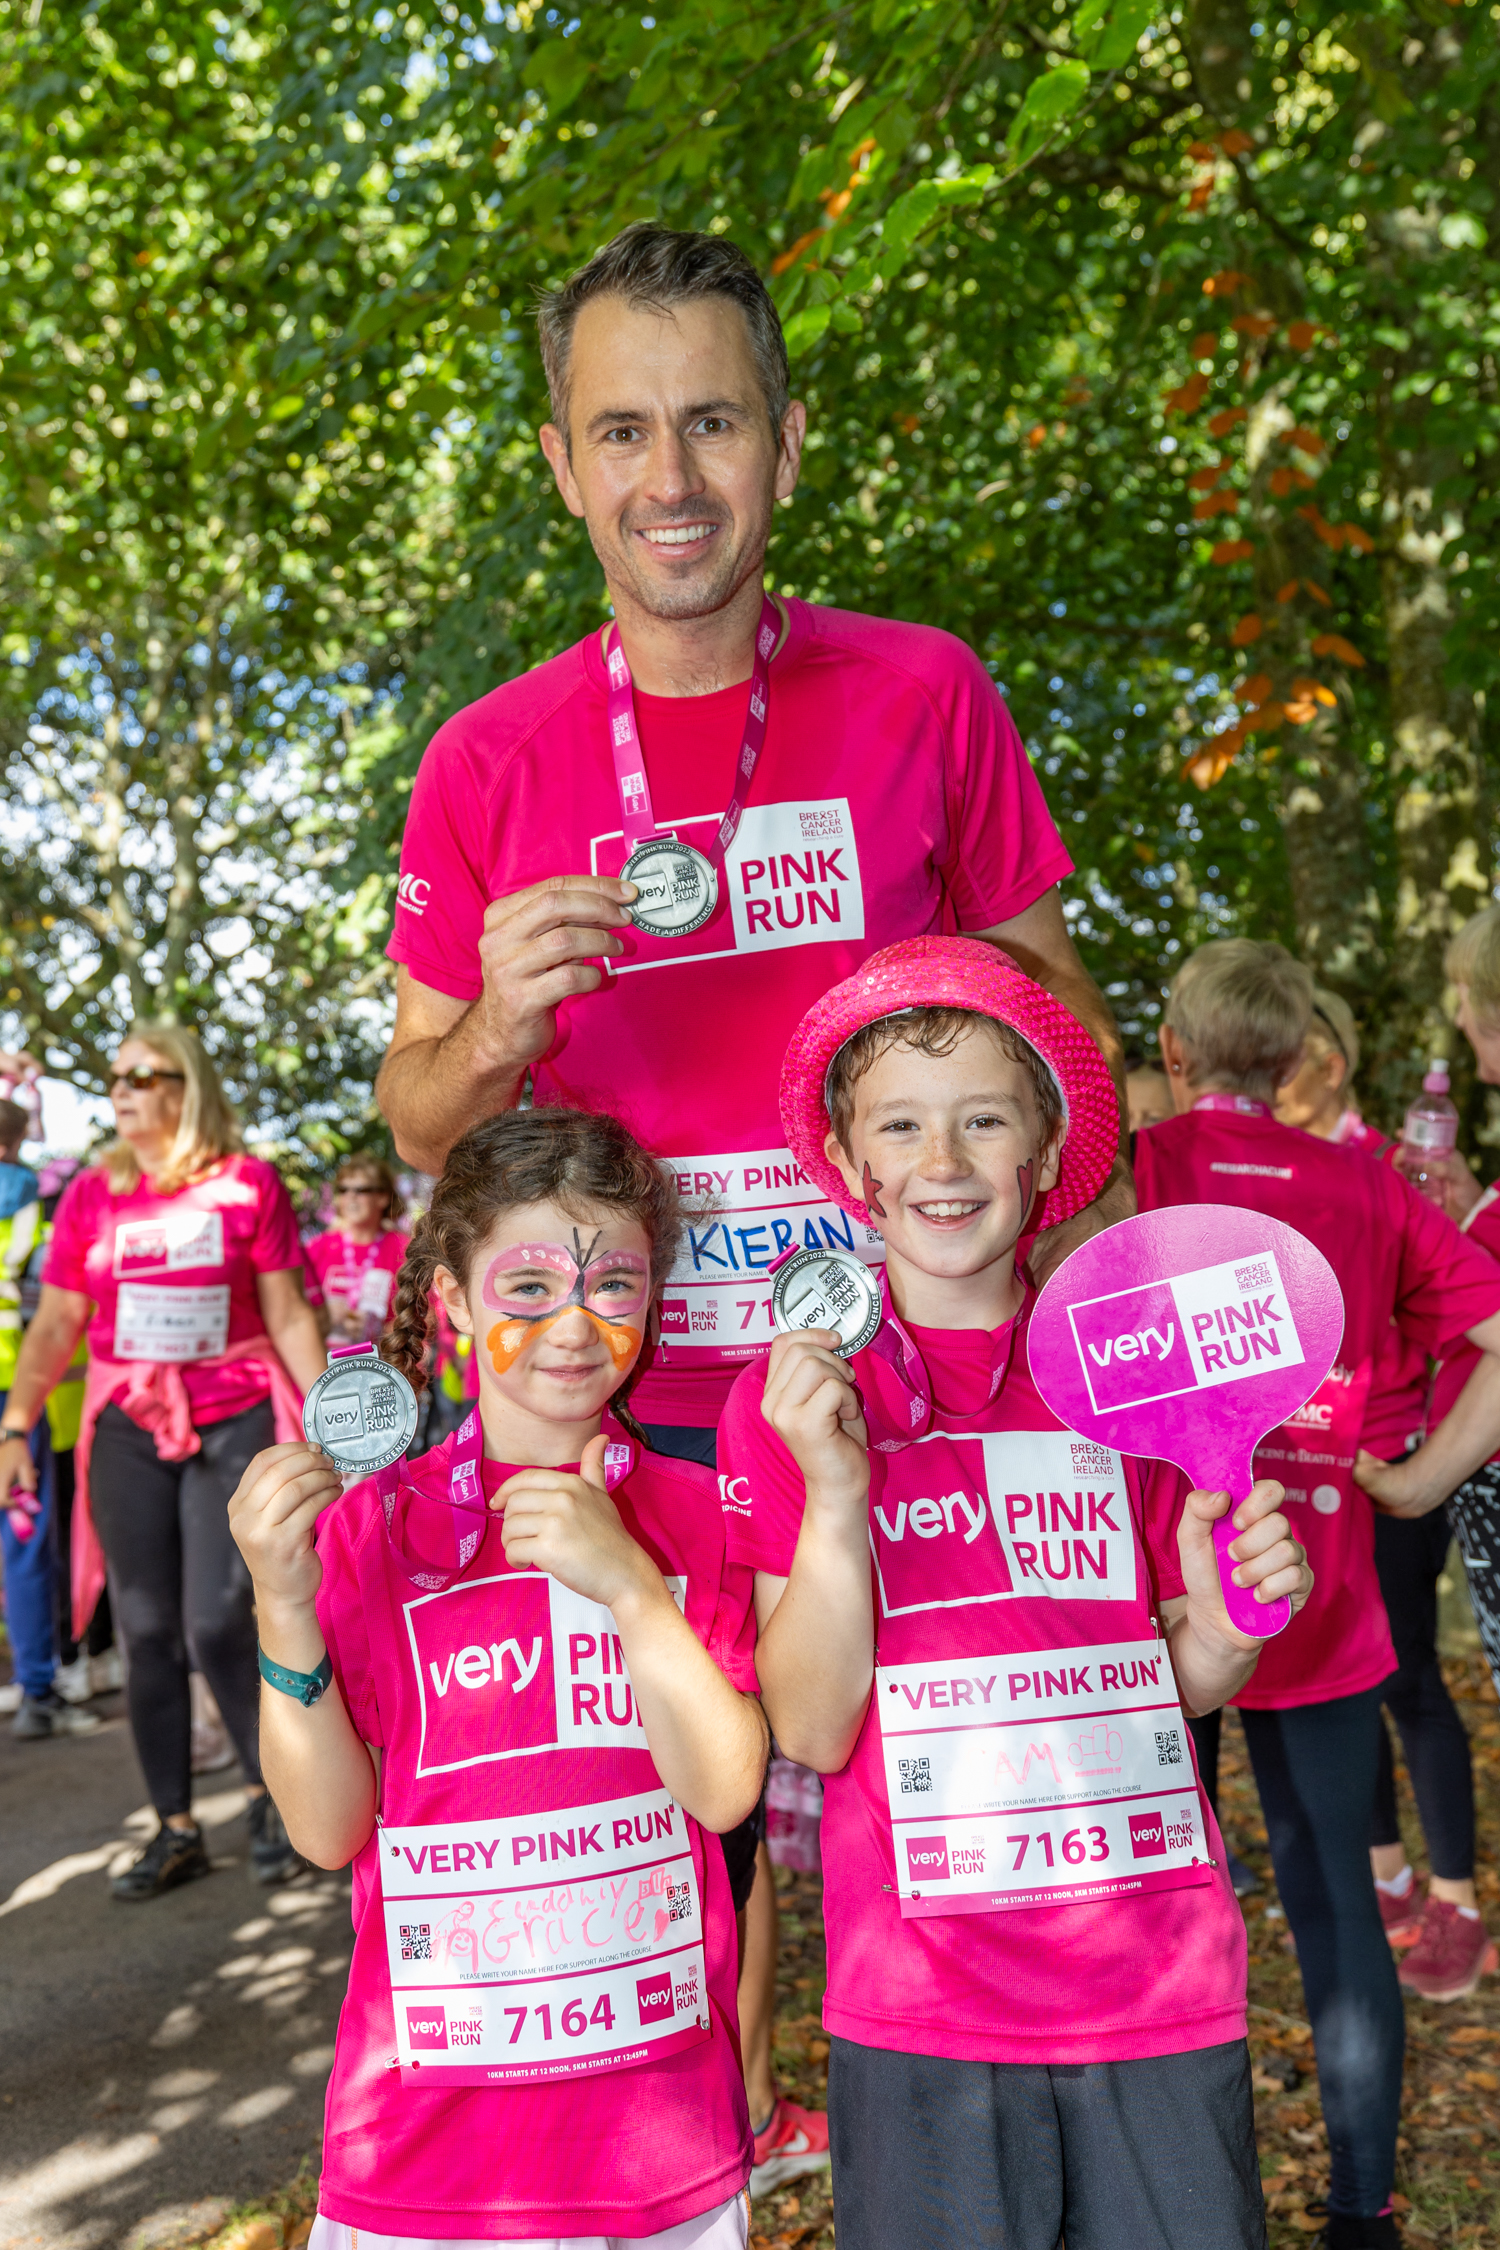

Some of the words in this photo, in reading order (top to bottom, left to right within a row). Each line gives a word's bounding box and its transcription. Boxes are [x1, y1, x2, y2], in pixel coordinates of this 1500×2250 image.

[801, 818, 841, 830] CANCER
[802, 826, 843, 837] IRELAND
[740, 848, 850, 895] PINK
[638, 885, 666, 899] very
[671, 878, 700, 894] PINK
[674, 888, 700, 902] RUN
[638, 920, 661, 934] MADE
[672, 902, 714, 935] DIFFERENCE
[745, 888, 841, 935] RUN
[744, 1163, 812, 1191] PINK
[688, 1207, 855, 1271] KIERAN
[774, 1282, 786, 1302] VERY
[781, 1267, 794, 1283] PINK
[792, 1256, 808, 1268] RUN
[808, 1252, 826, 1260] 2023
[1236, 1270, 1270, 1284] CANCER
[1238, 1276, 1272, 1290] IRELAND
[826, 1277, 854, 1306] PINK
[834, 1288, 860, 1314] RUN
[661, 1311, 686, 1324] very
[691, 1311, 719, 1321] PINK
[736, 1298, 776, 1330] 71
[799, 1302, 826, 1329] very
[848, 1346, 854, 1354] A
[854, 1294, 879, 1348] DIFFERENCE
[1191, 1294, 1284, 1342] PINK
[692, 1322, 716, 1331] RUN
[737, 1348, 756, 1356] STARTS
[1087, 1322, 1175, 1367] very
[1200, 1328, 1282, 1373] RUN
[319, 1369, 335, 1386] VERY
[336, 1362, 354, 1373] PINK
[356, 1360, 373, 1368] RUN
[374, 1362, 392, 1375] 2023
[325, 1410, 358, 1425] very
[365, 1404, 397, 1420] PINK
[366, 1416, 395, 1432] RUN
[360, 1434, 411, 1471] DIFFERENCE
[1072, 1455, 1112, 1465] CANCER
[1073, 1465, 1114, 1475] IRELAND
[459, 1478, 469, 1499] very
[873, 1490, 987, 1545] very
[1004, 1491, 1122, 1534] PINK
[1011, 1539, 1108, 1581] RUN
[429, 1636, 543, 1698] very
[900, 1675, 998, 1710] VERY
[1008, 1666, 1094, 1701] PINK
[1099, 1658, 1160, 1691] RUN
[571, 1682, 643, 1727] RU
[1020, 1797, 1038, 1805] NAME
[1038, 1795, 1053, 1803] HERE
[1054, 1794, 1066, 1802] FOR
[1067, 1790, 1092, 1800] SUPPORT
[1093, 1788, 1112, 1797] ALONG
[1122, 1784, 1142, 1793] COURSE
[1132, 1826, 1162, 1842] very
[1166, 1822, 1194, 1836] PINK
[402, 1839, 500, 1875] VERY
[511, 1824, 605, 1866] PINK
[612, 1808, 674, 1849] RUN
[1006, 1825, 1110, 1872] 7163
[1168, 1834, 1192, 1849] RUN
[910, 1851, 946, 1867] very
[952, 1848, 986, 1862] PINK
[953, 1862, 984, 1874] RUN
[991, 1898, 1009, 1906] 10KM
[1010, 1896, 1033, 1904] STARTS
[1052, 1891, 1074, 1900] NOON,
[1074, 1889, 1088, 1897] 5KM
[1088, 1886, 1110, 1896] STARTS
[1110, 1884, 1118, 1892] AT
[1118, 1880, 1142, 1890] 12:45PM
[482, 1899, 648, 1964] Grace
[460, 1972, 480, 1980] PLEASE
[518, 1967, 537, 1976] NAME
[538, 1965, 554, 1973] HERE
[556, 1963, 568, 1971] FOR
[570, 1958, 597, 1970] SUPPORT
[598, 1954, 619, 1964] ALONG
[620, 1950, 630, 1958] THE
[631, 1945, 652, 1956] COURSE
[640, 1988, 670, 2008] very
[675, 1978, 698, 1998] PINK
[676, 1992, 698, 2010] RUN
[410, 2020, 444, 2037] very
[450, 2020, 484, 2032] PINK
[503, 1993, 616, 2045] 7164
[451, 2034, 481, 2046] RUN
[487, 2071, 504, 2079] 10KM
[506, 2070, 528, 2078] STARTS
[550, 2064, 572, 2074] NOON,
[572, 2062, 588, 2071] 5KM
[588, 2058, 612, 2068] STARTS
[614, 2056, 622, 2064] AT
[622, 2049, 648, 2062] 12:45PM
